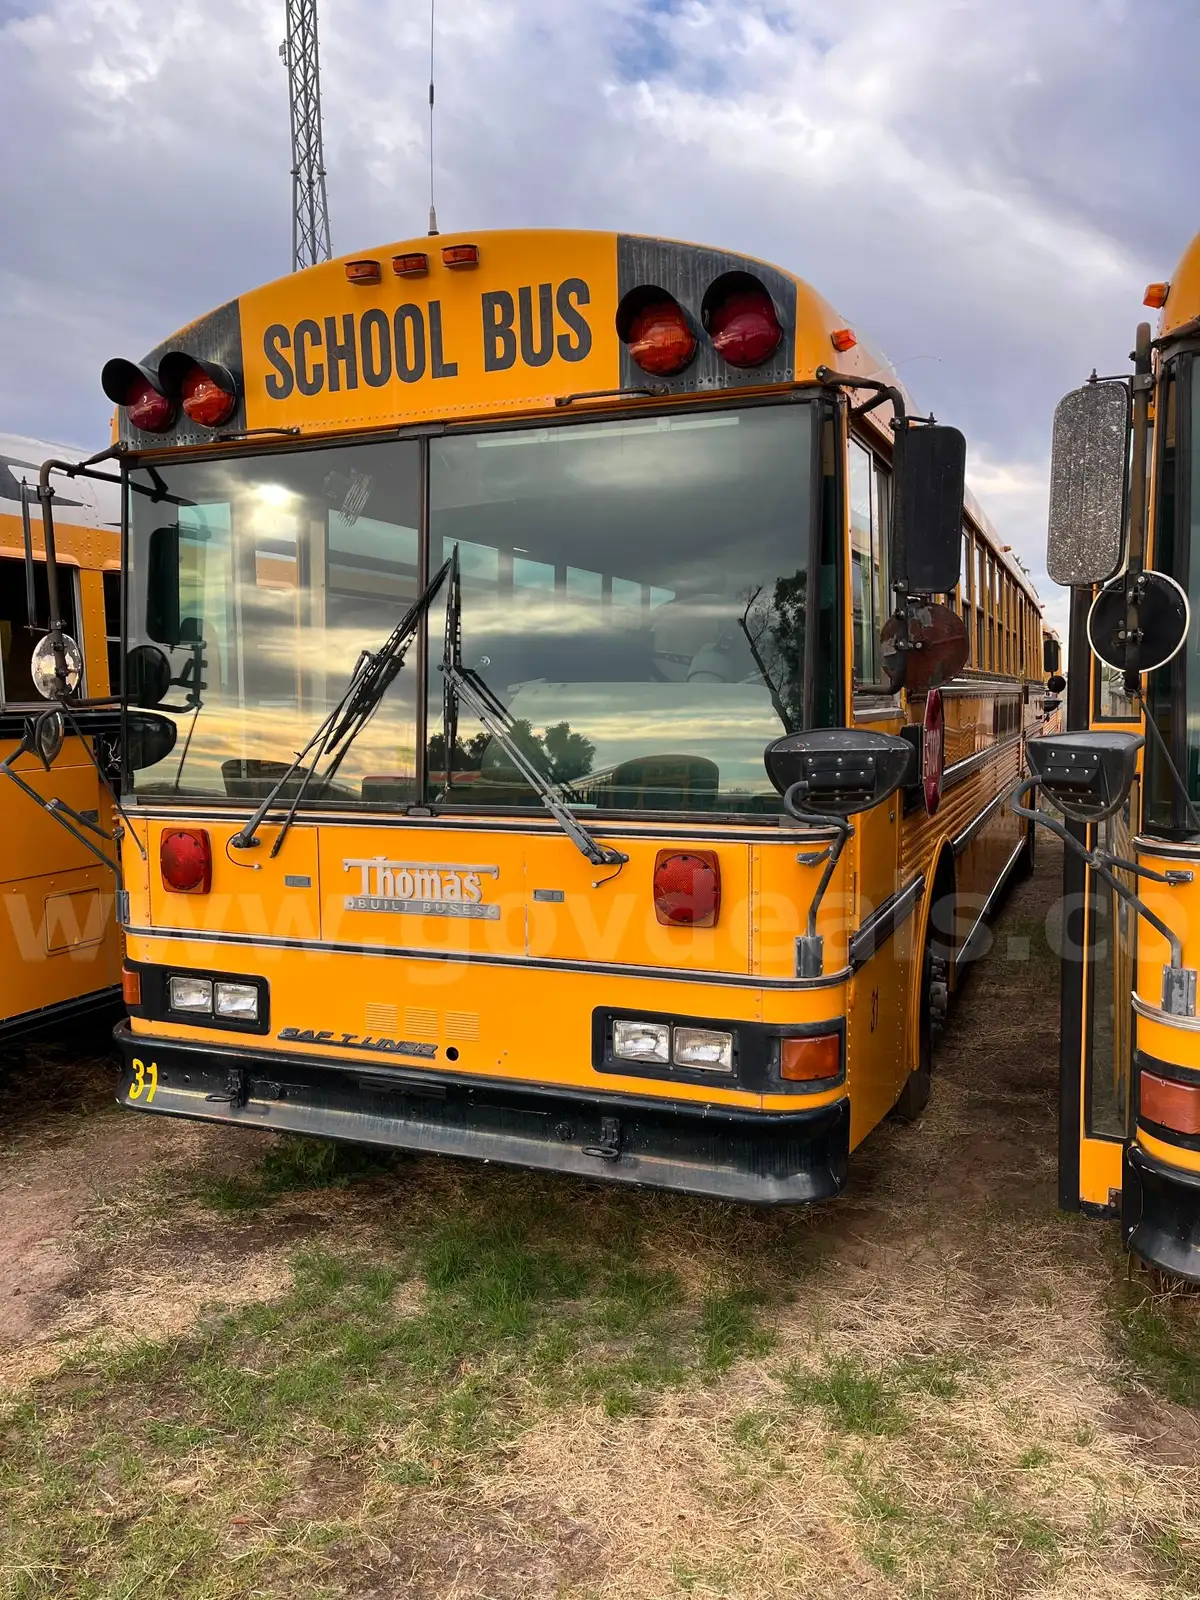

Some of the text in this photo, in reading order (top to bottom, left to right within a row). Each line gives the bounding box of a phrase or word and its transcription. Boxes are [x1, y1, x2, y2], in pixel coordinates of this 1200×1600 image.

[263, 277, 593, 400] SCHOOL BUS
[926, 728, 941, 778] STOP
[343, 856, 499, 903] Thomas
[358, 899, 484, 917] BUILT BUSES
[128, 1058, 158, 1103] 31
